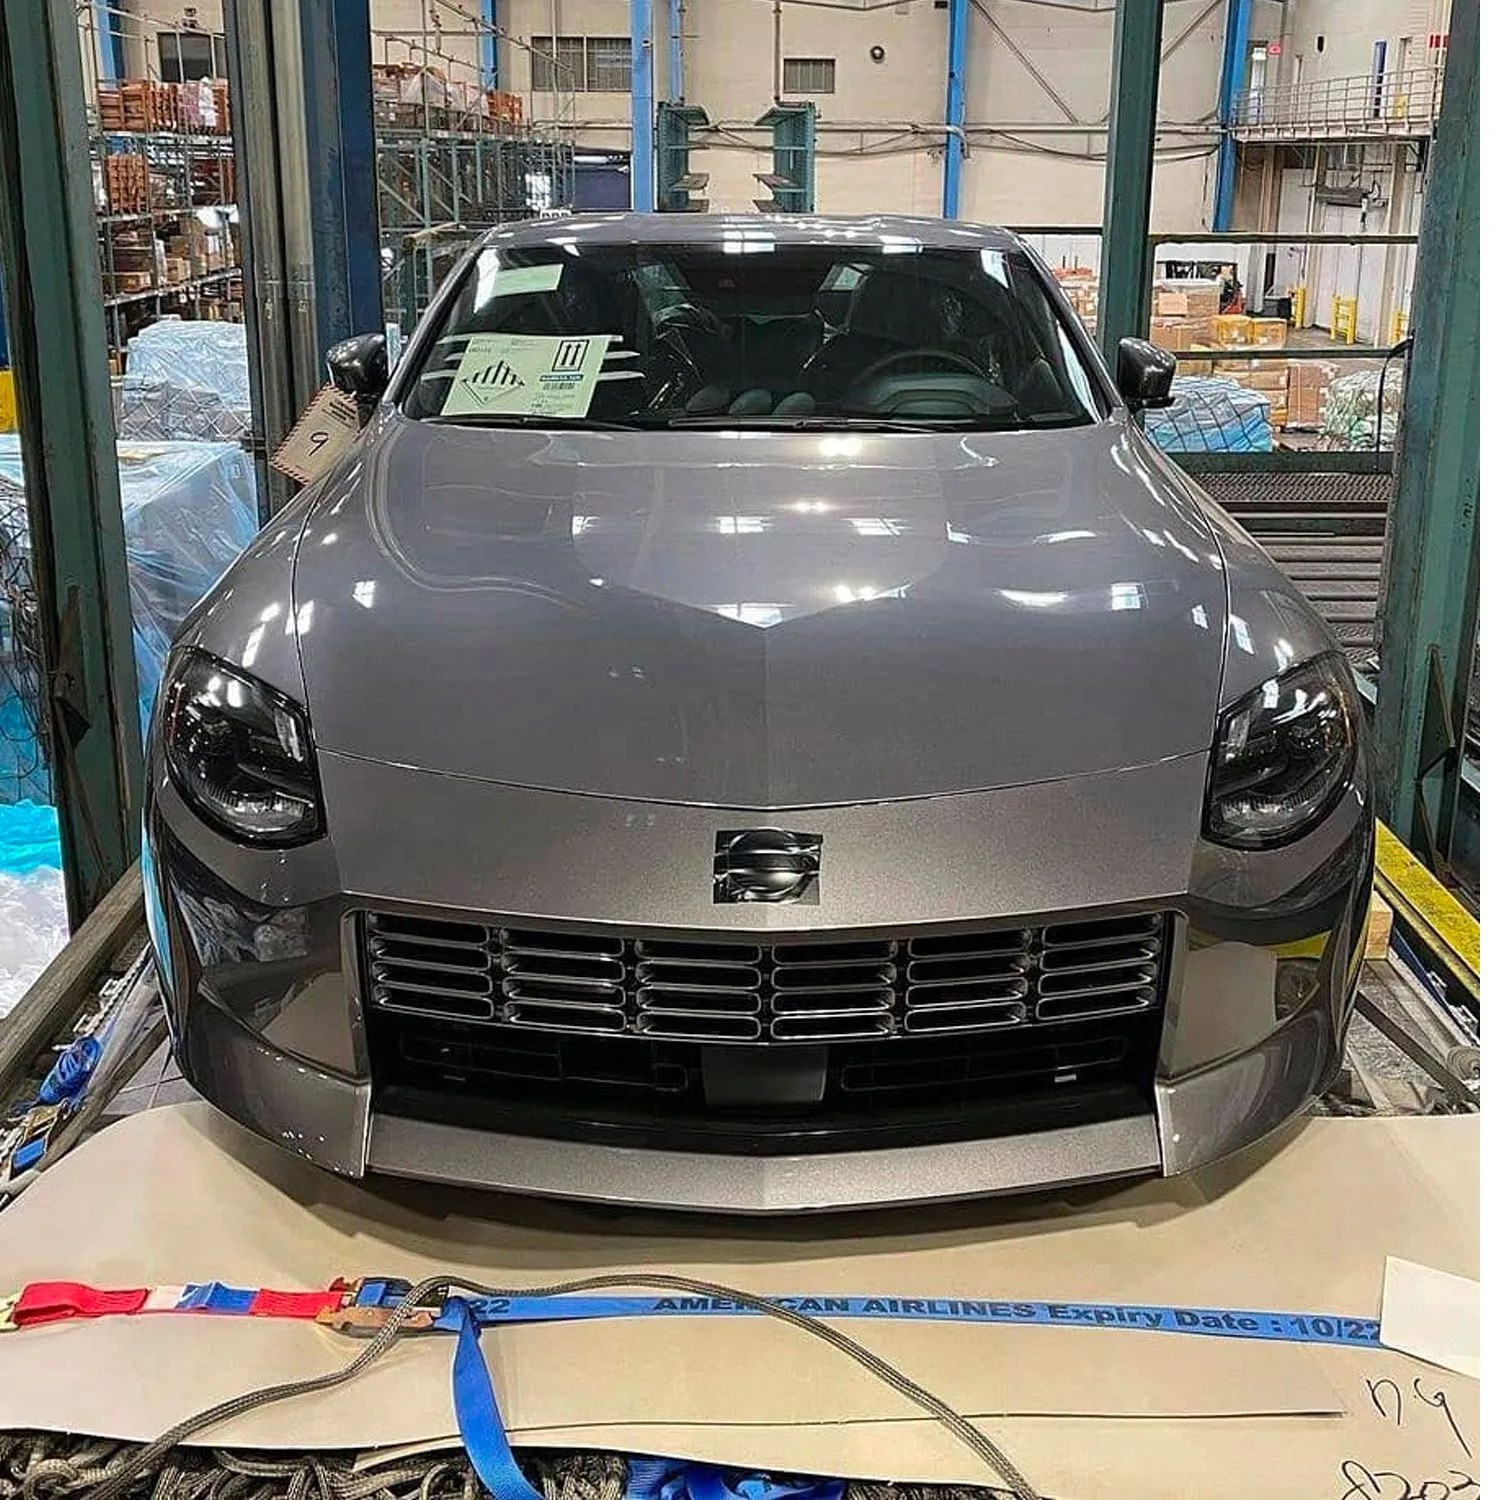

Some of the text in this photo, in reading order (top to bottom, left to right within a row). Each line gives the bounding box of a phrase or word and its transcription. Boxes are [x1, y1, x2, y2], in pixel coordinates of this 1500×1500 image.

[653, 1297, 850, 1311] AMECAN
[862, 1299, 1037, 1319] AIRLINES
[1049, 1304, 1163, 1328] Expiry
[1173, 1310, 1259, 1331] Date
